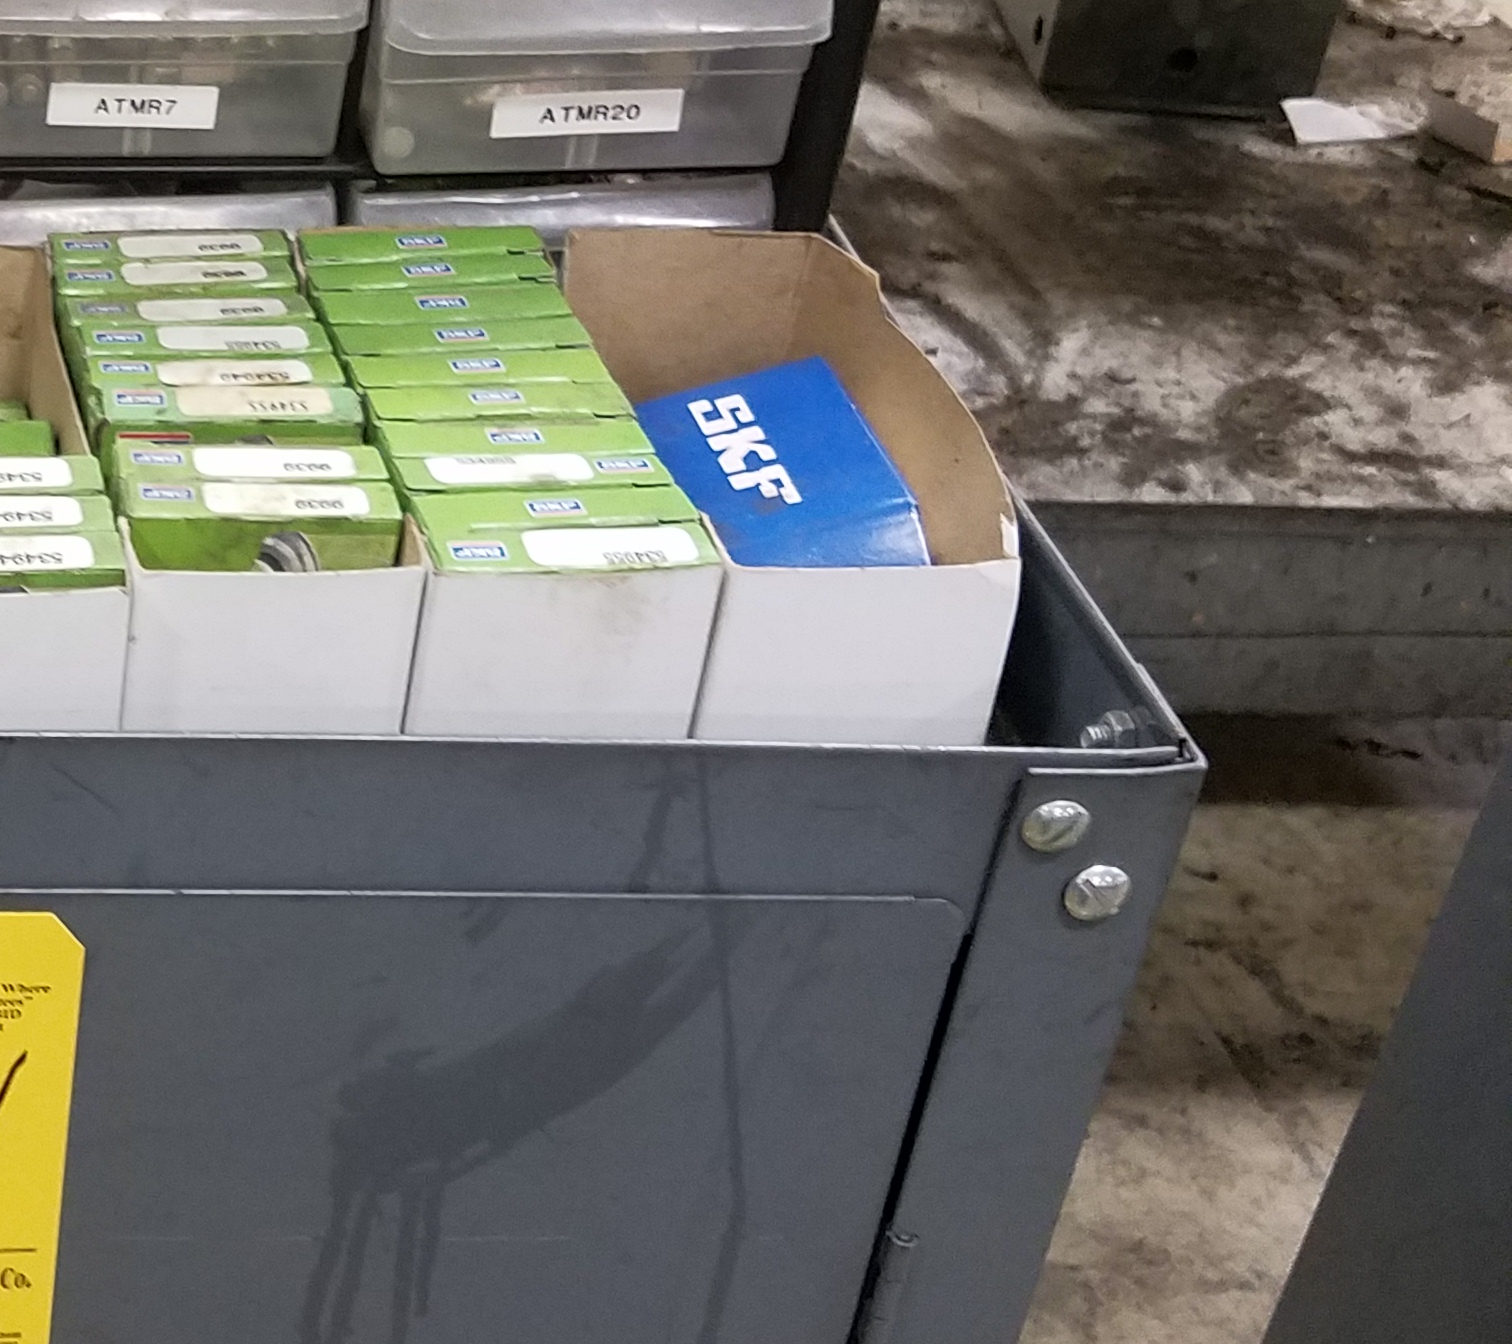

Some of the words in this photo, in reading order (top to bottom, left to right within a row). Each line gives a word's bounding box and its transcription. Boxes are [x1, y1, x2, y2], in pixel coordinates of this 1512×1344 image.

[95, 98, 177, 114] ATMR7
[540, 104, 640, 123] ATMR20
[687, 394, 803, 507] SKF
[0, 983, 52, 994] Where
[0, 1267, 33, 1290] Co.
